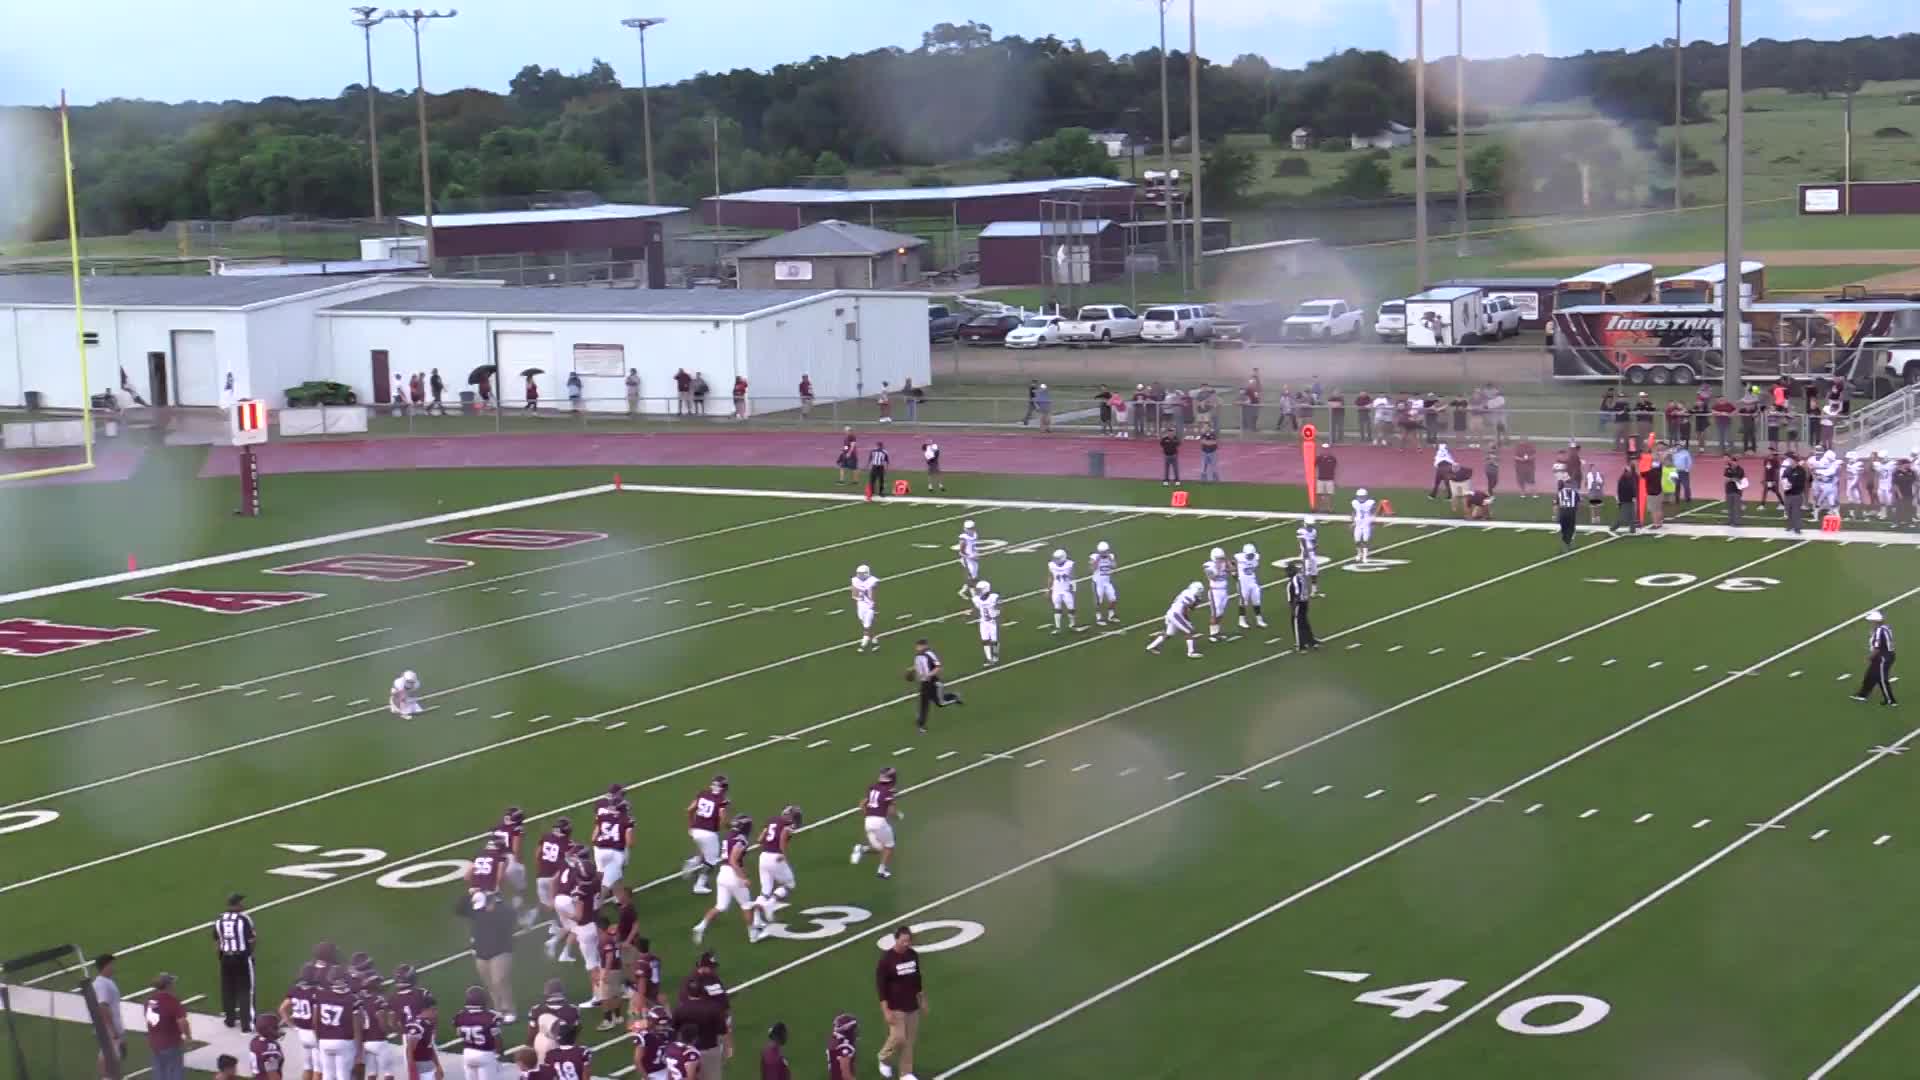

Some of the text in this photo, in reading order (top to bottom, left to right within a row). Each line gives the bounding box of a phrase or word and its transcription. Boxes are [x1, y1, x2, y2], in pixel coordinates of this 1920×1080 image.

[1605, 315, 1724, 330] INDUSTRIA
[1823, 518, 1839, 531] 30
[696, 797, 715, 818] 50
[869, 789, 880, 808] 11
[597, 821, 620, 843] 54
[766, 823, 777, 842] 5
[266, 848, 471, 888] 20
[757, 905, 985, 953] 30
[291, 998, 312, 1020] 20
[319, 1003, 344, 1026] 57
[1354, 978, 1612, 1036] 40
[459, 1025, 486, 1045] 75
